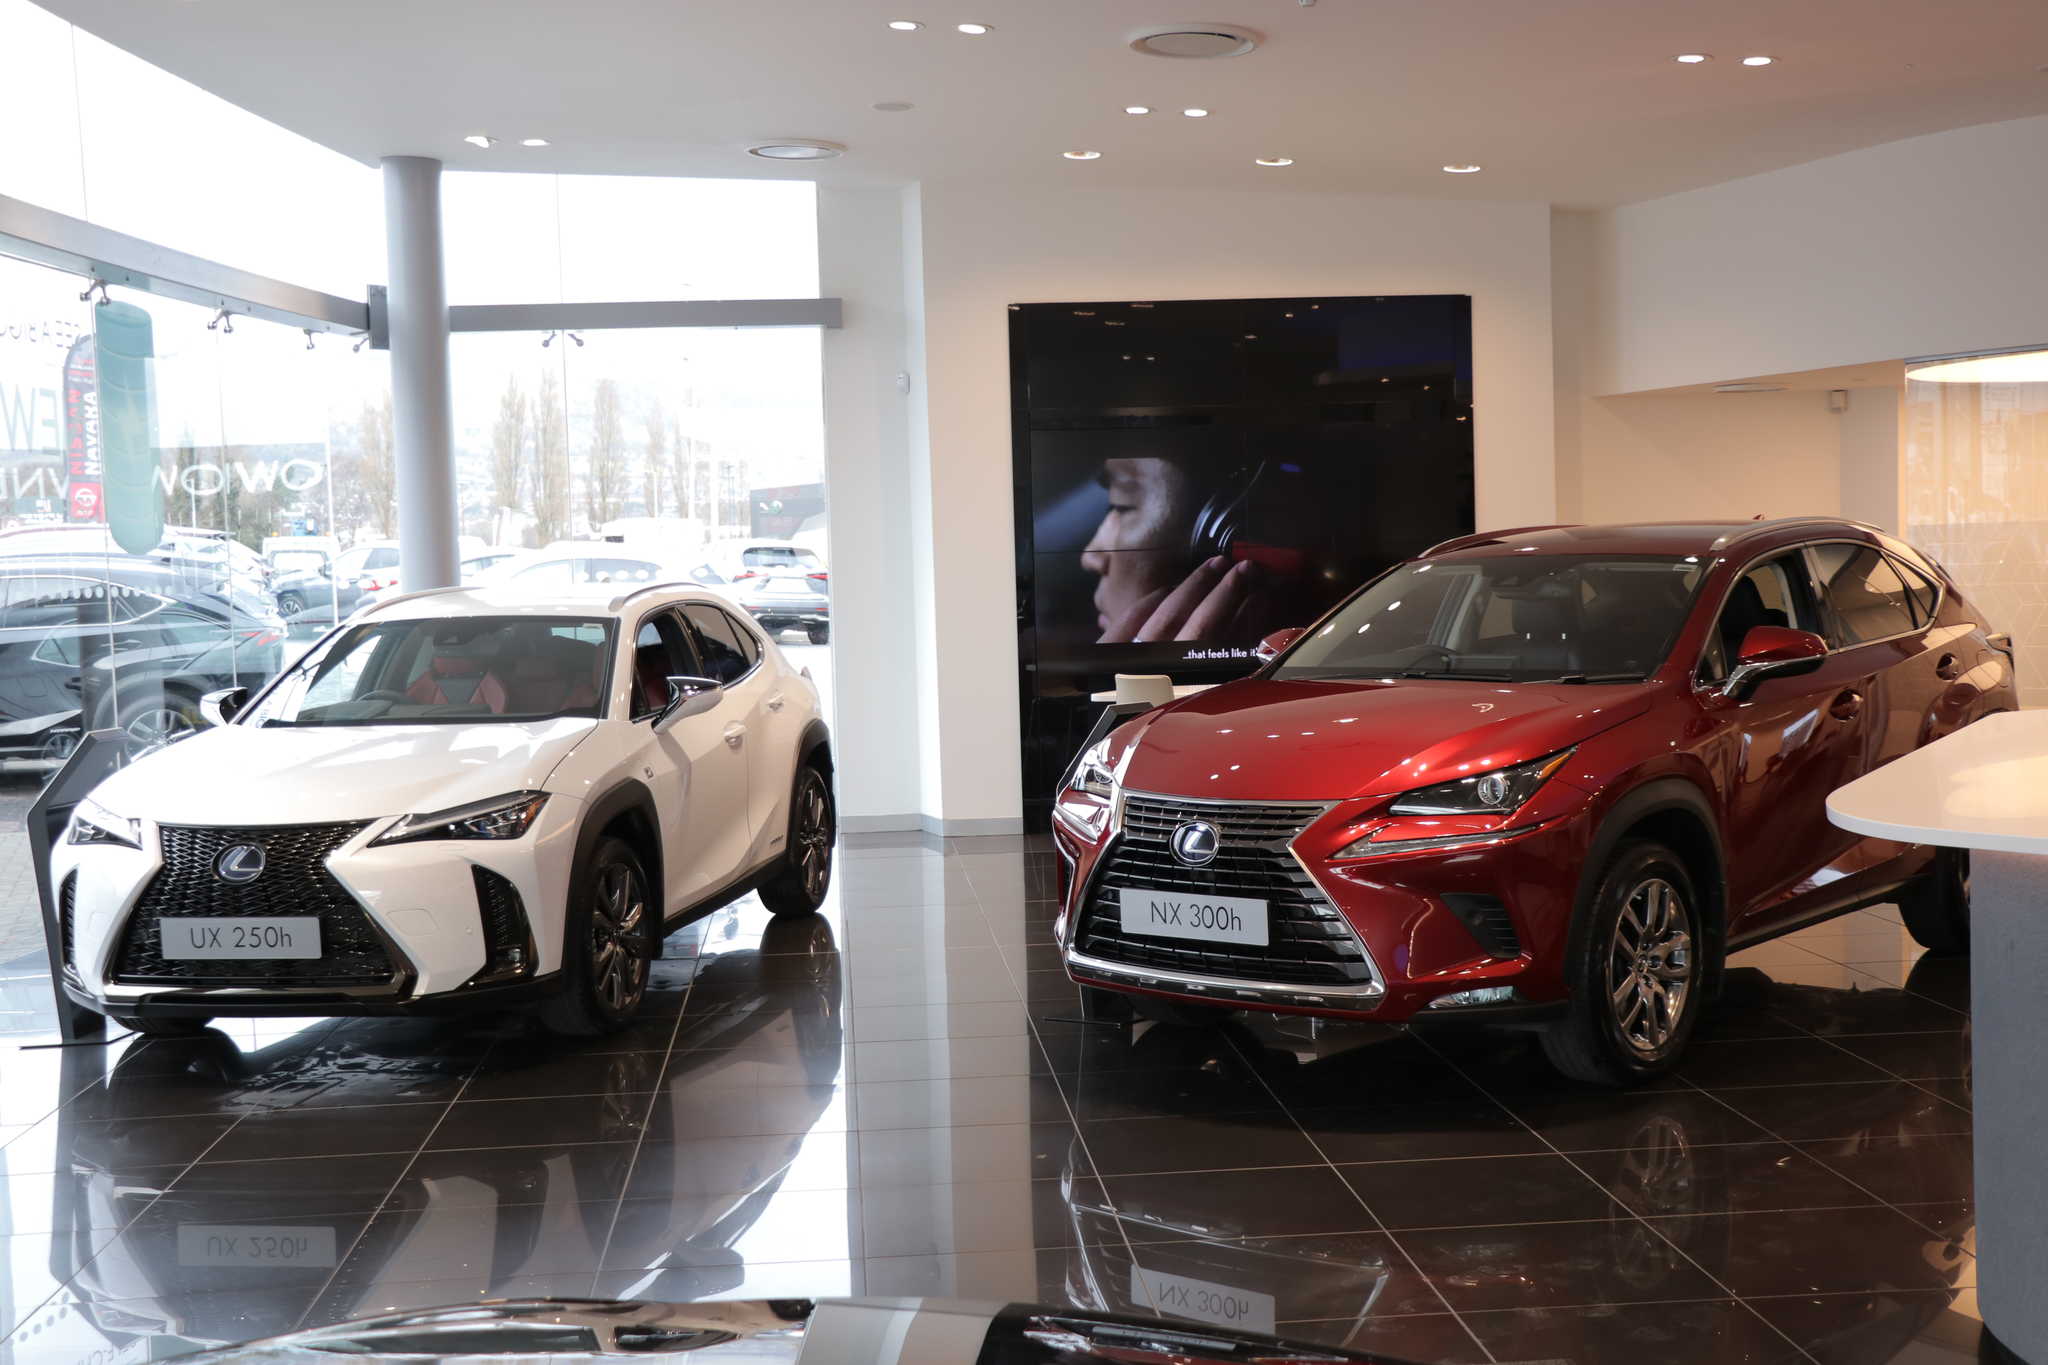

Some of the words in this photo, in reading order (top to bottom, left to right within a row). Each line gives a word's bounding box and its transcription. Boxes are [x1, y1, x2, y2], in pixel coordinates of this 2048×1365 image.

[1207, 648, 1230, 659] feels
[1231, 647, 1248, 658] like
[1151, 901, 1183, 926] NX
[1189, 903, 1243, 932] 300h
[190, 927, 223, 949] UX
[232, 926, 293, 949] 250h
